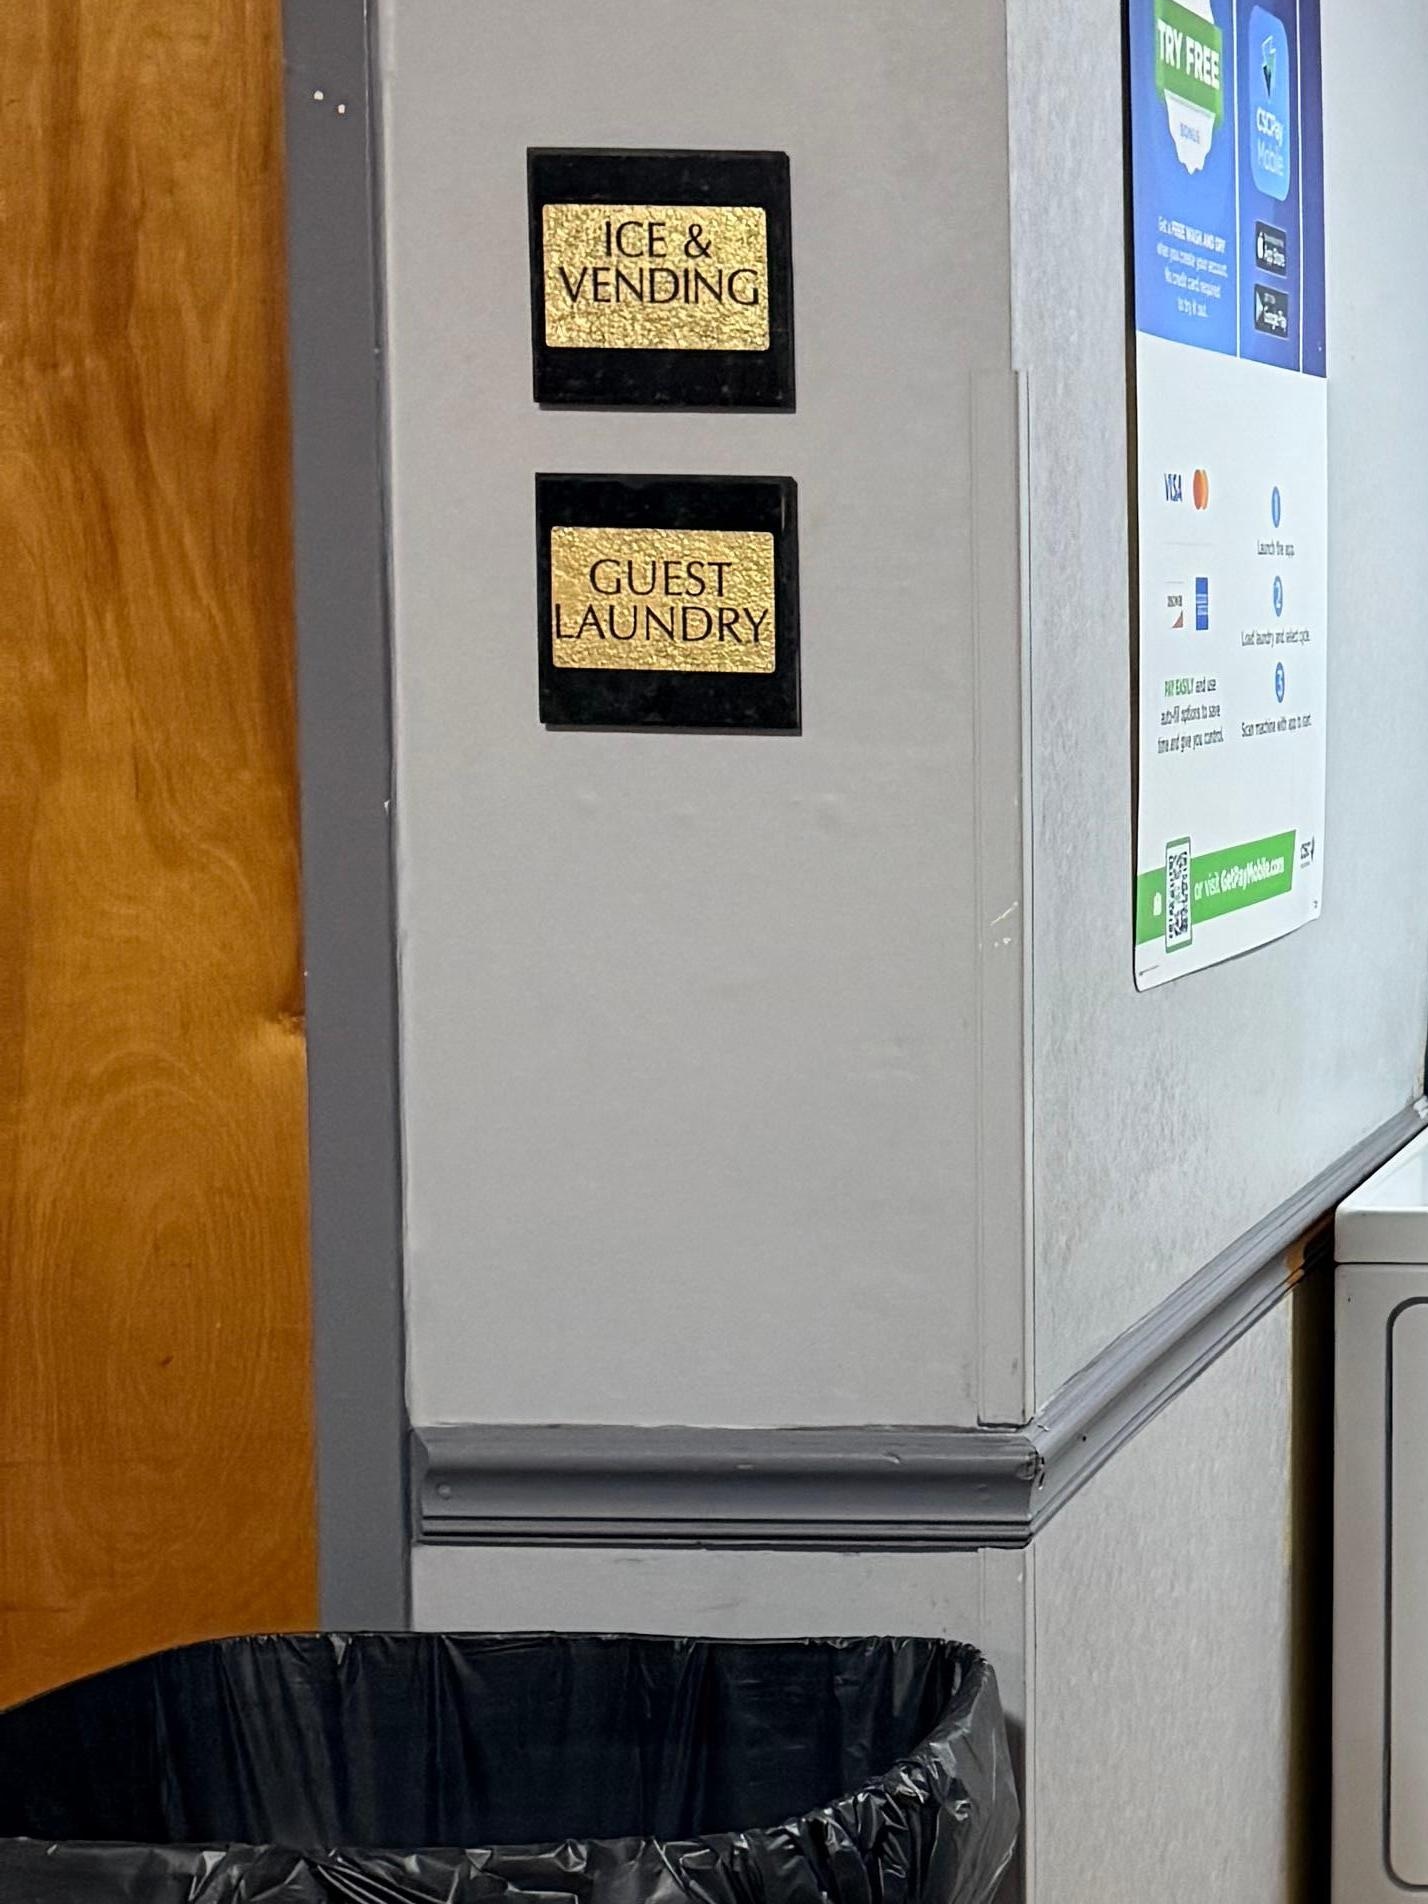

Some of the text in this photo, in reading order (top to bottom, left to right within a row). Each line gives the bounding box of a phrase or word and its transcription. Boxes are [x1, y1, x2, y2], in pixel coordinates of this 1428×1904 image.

[1157, 17, 1220, 90] TRY FREE
[603, 217, 713, 259] ICE &
[558, 266, 760, 306] VENDING
[1164, 472, 1183, 503] VISA
[588, 558, 732, 597] GUEST
[554, 603, 769, 644] LAUNDRY
[1194, 881, 1203, 901] or
[1204, 870, 1220, 897] visit
